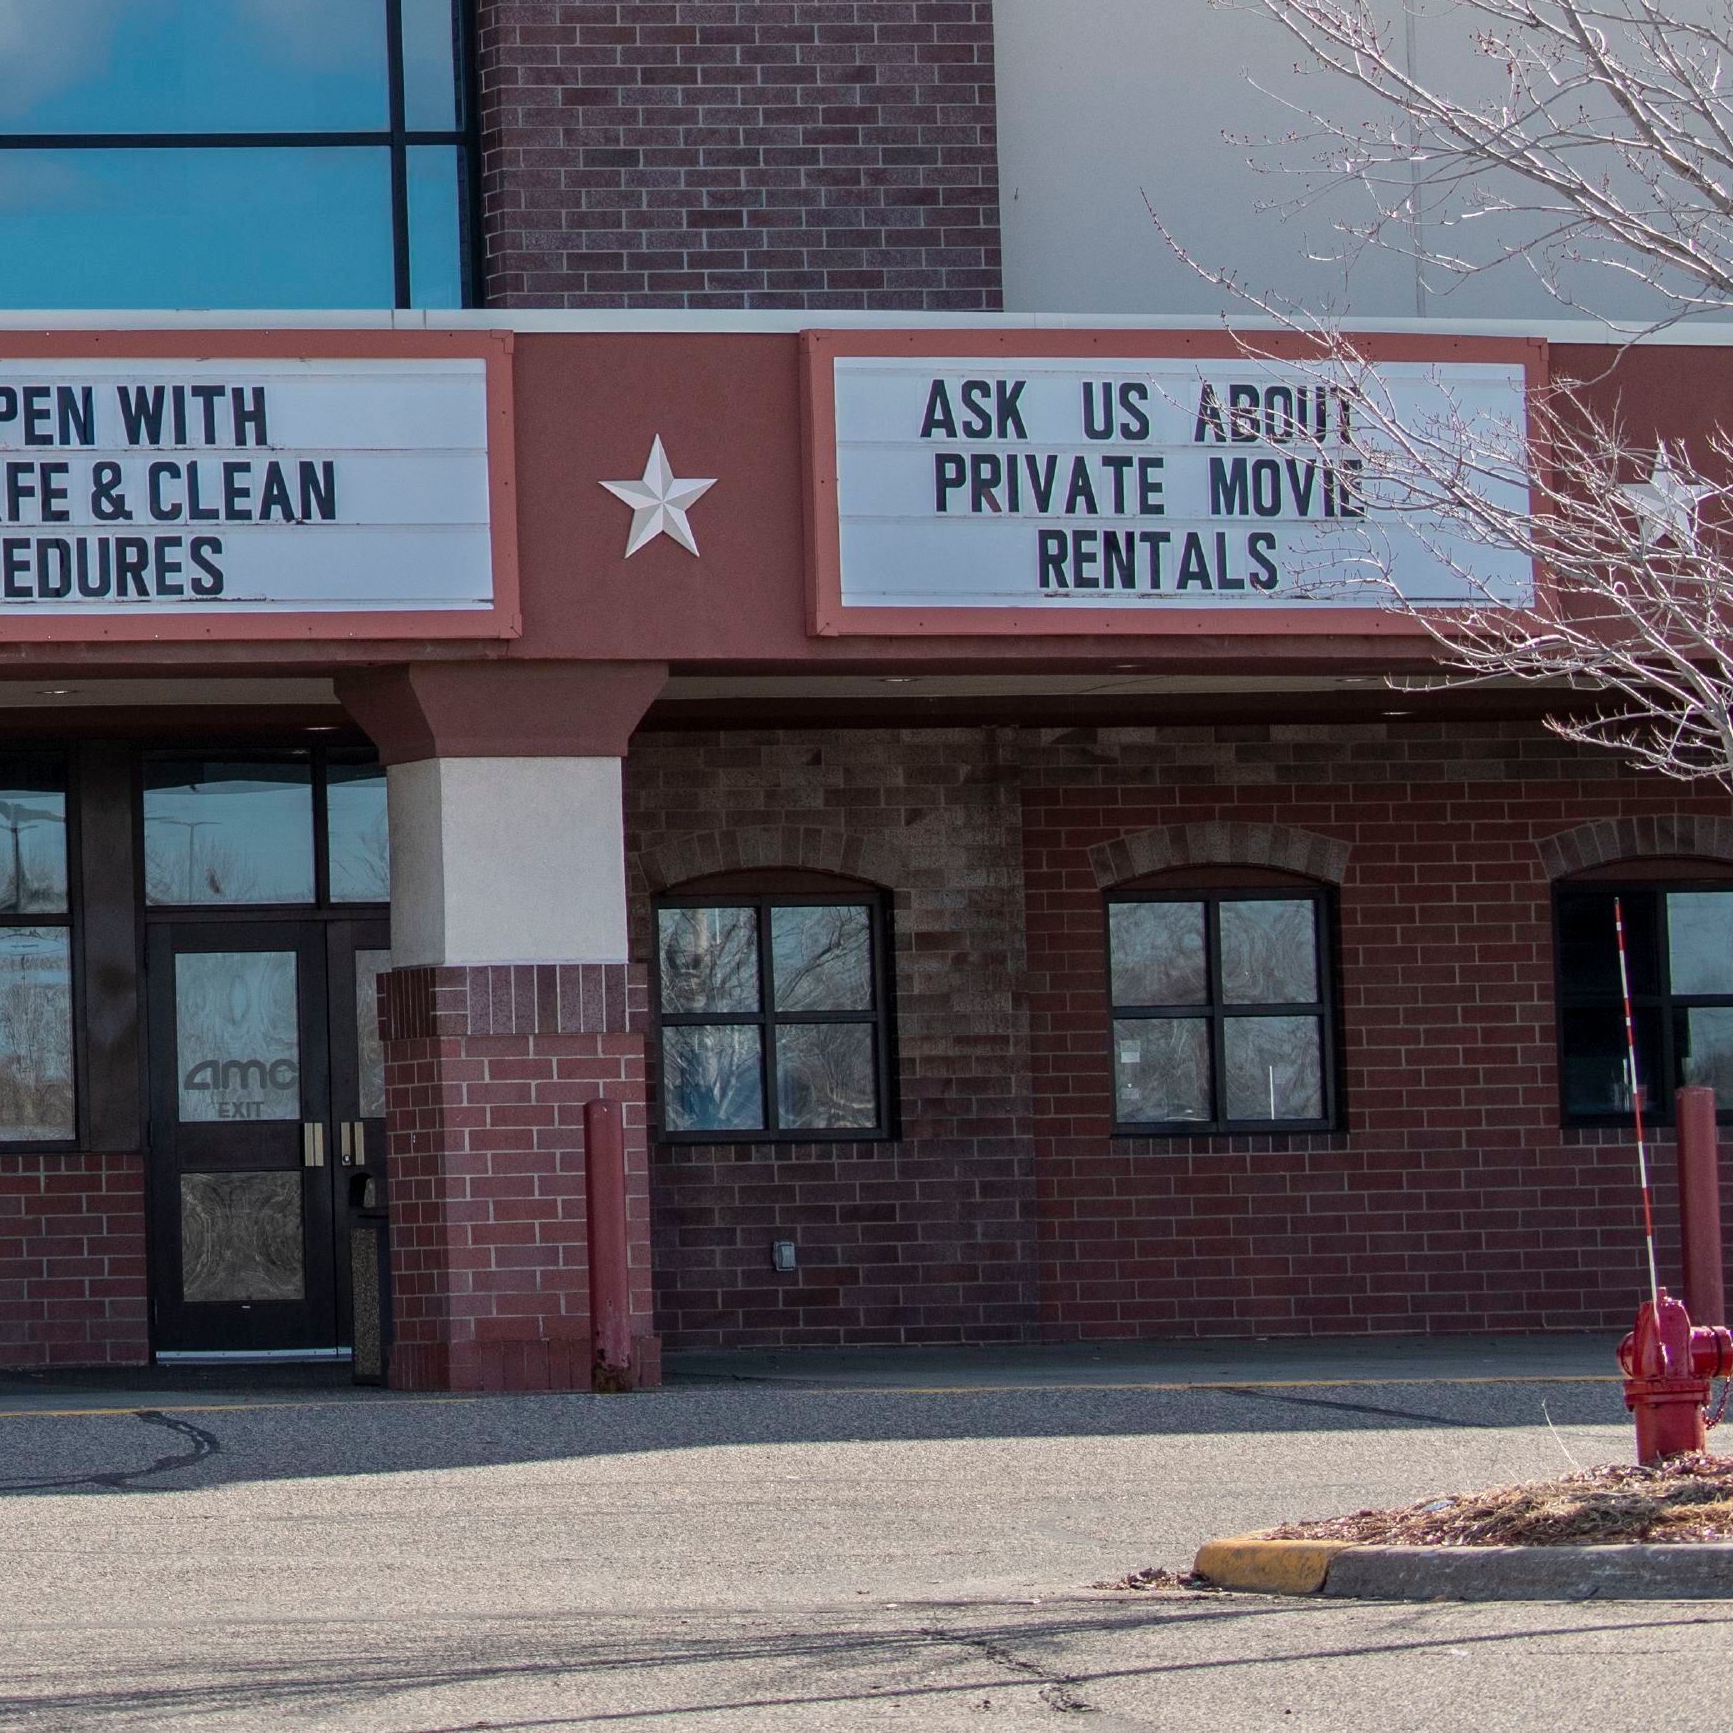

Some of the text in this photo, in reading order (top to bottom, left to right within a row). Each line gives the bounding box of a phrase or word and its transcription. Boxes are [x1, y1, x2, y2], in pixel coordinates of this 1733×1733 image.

[117, 385, 266, 445] WITH
[920, 379, 1362, 444] ASK US ABOUT
[90, 459, 131, 520] &
[149, 461, 335, 521] CLEAN
[935, 453, 1364, 517] PRIVATE MOVIE
[1038, 529, 1278, 591] RENTALS
[219, 1101, 264, 1117] EXIT
